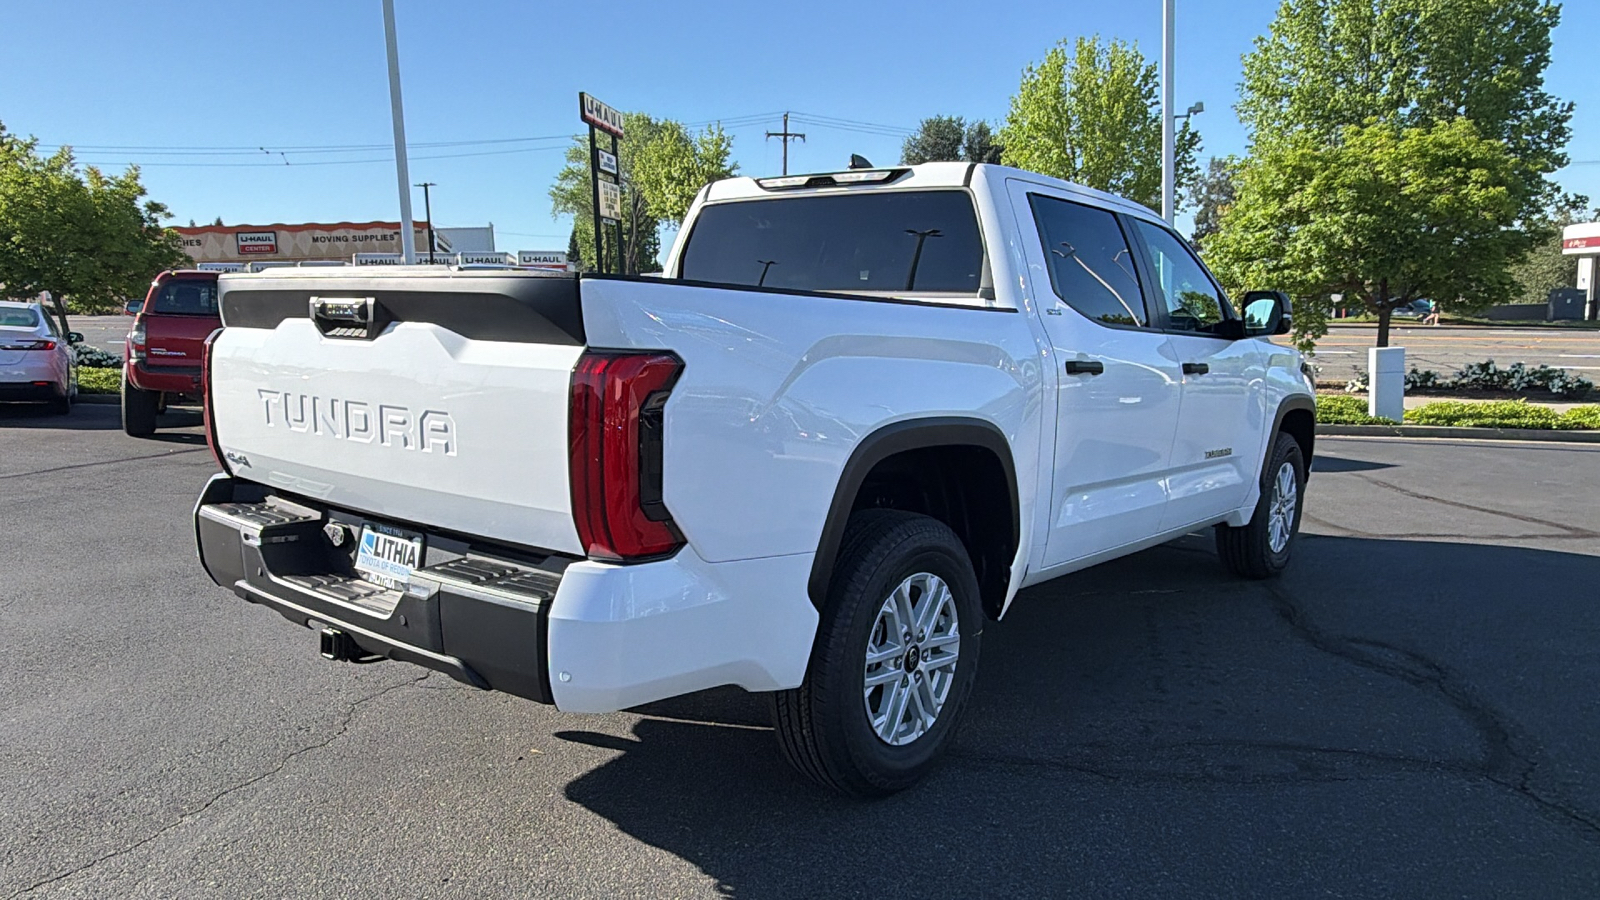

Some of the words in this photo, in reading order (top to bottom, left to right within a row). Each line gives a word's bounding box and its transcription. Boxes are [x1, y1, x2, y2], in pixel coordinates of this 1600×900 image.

[312, 235, 349, 243] MOVING
[352, 233, 395, 243] SUPPLIES
[257, 388, 458, 457] TUNDRA
[359, 554, 380, 568] TOYOTA
[381, 560, 390, 570] OF
[373, 535, 416, 568] LITHIA
